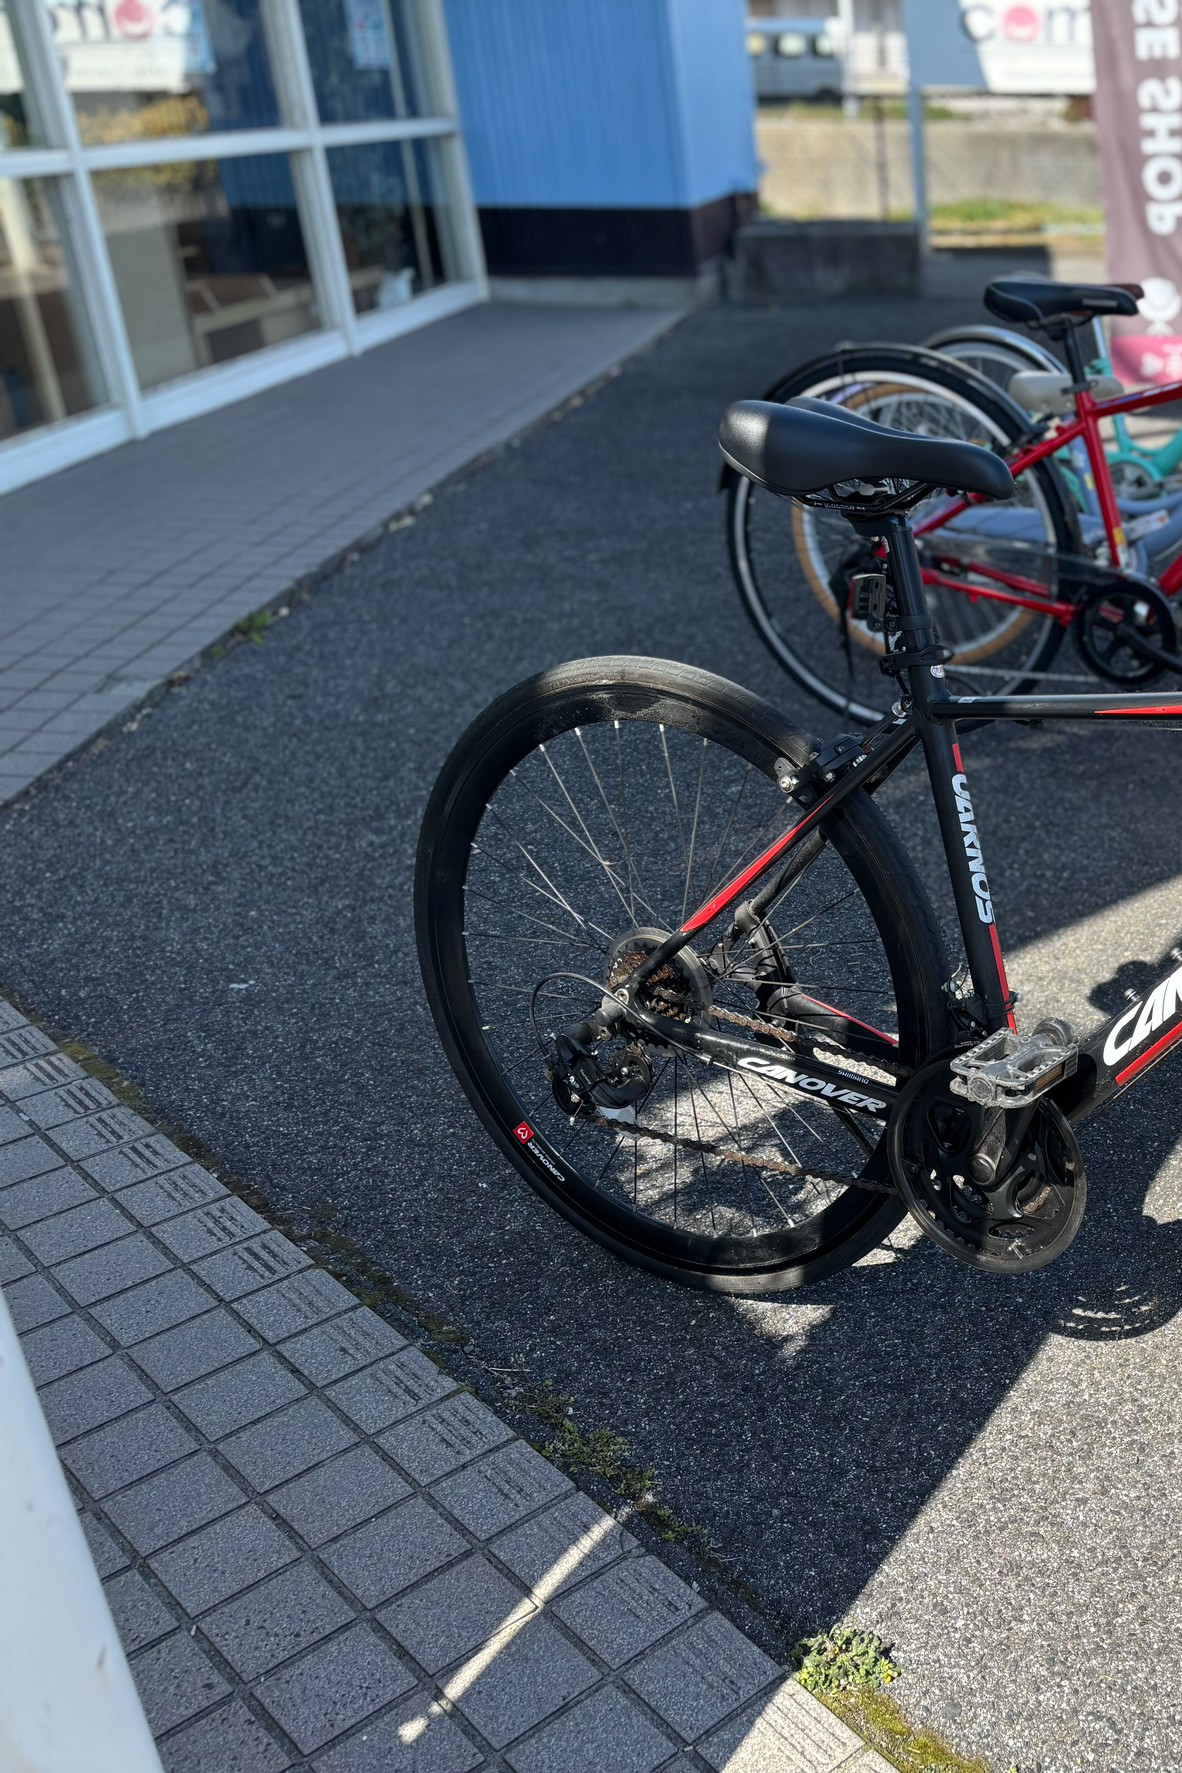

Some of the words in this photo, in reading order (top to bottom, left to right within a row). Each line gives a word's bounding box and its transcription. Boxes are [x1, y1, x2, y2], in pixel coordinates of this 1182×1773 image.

[951, 773, 997, 925] UARNOS
[738, 1057, 886, 1112] CANOVER
[838, 1069, 869, 1085] SHIMANO
[527, 1142, 565, 1182] CANOVER
